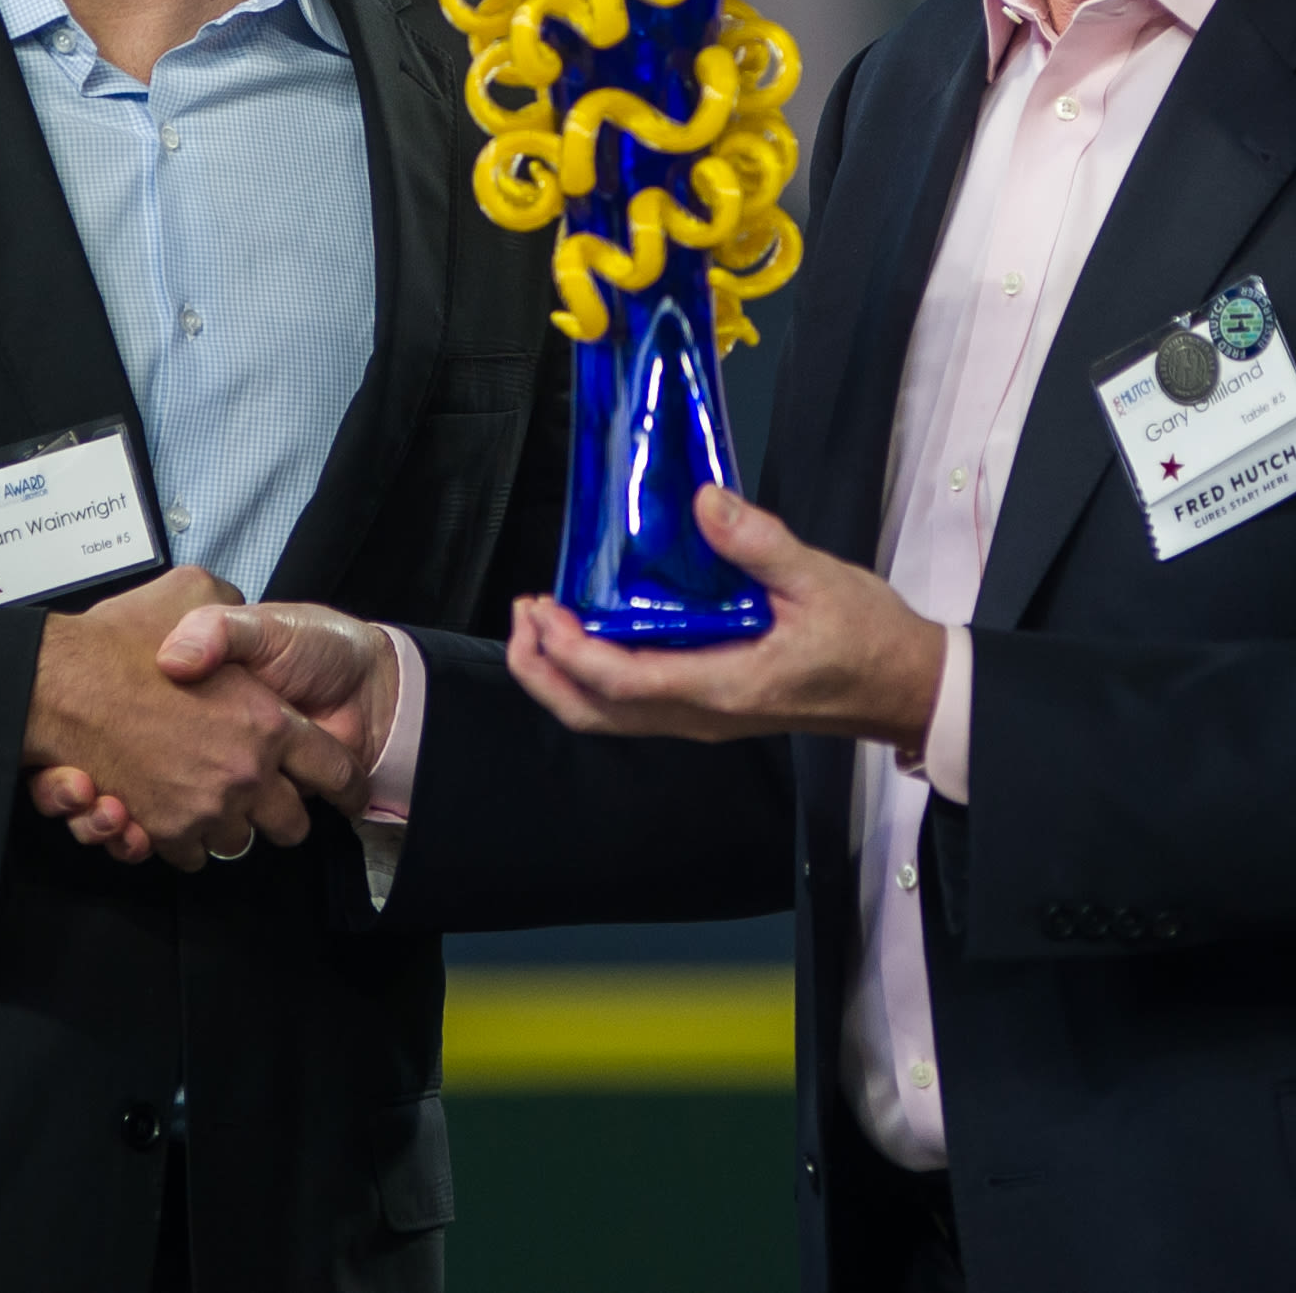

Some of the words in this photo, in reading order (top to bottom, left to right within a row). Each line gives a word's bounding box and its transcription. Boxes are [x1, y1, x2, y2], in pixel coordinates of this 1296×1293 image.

[1209, 294, 1229, 340] HUTCH
[1217, 341, 1247, 360] FRED
[1145, 407, 1189, 442] Gary
[1240, 402, 1270, 425] Table
[4, 474, 46, 499] AWARD
[1174, 484, 1225, 522] FRED
[1194, 508, 1228, 529] CURES
[1230, 489, 1260, 511] START
[1263, 473, 1289, 494] HERE
[25, 492, 127, 535] Wainwright
[81, 538, 113, 556] Table
[116, 532, 131, 546] #5
